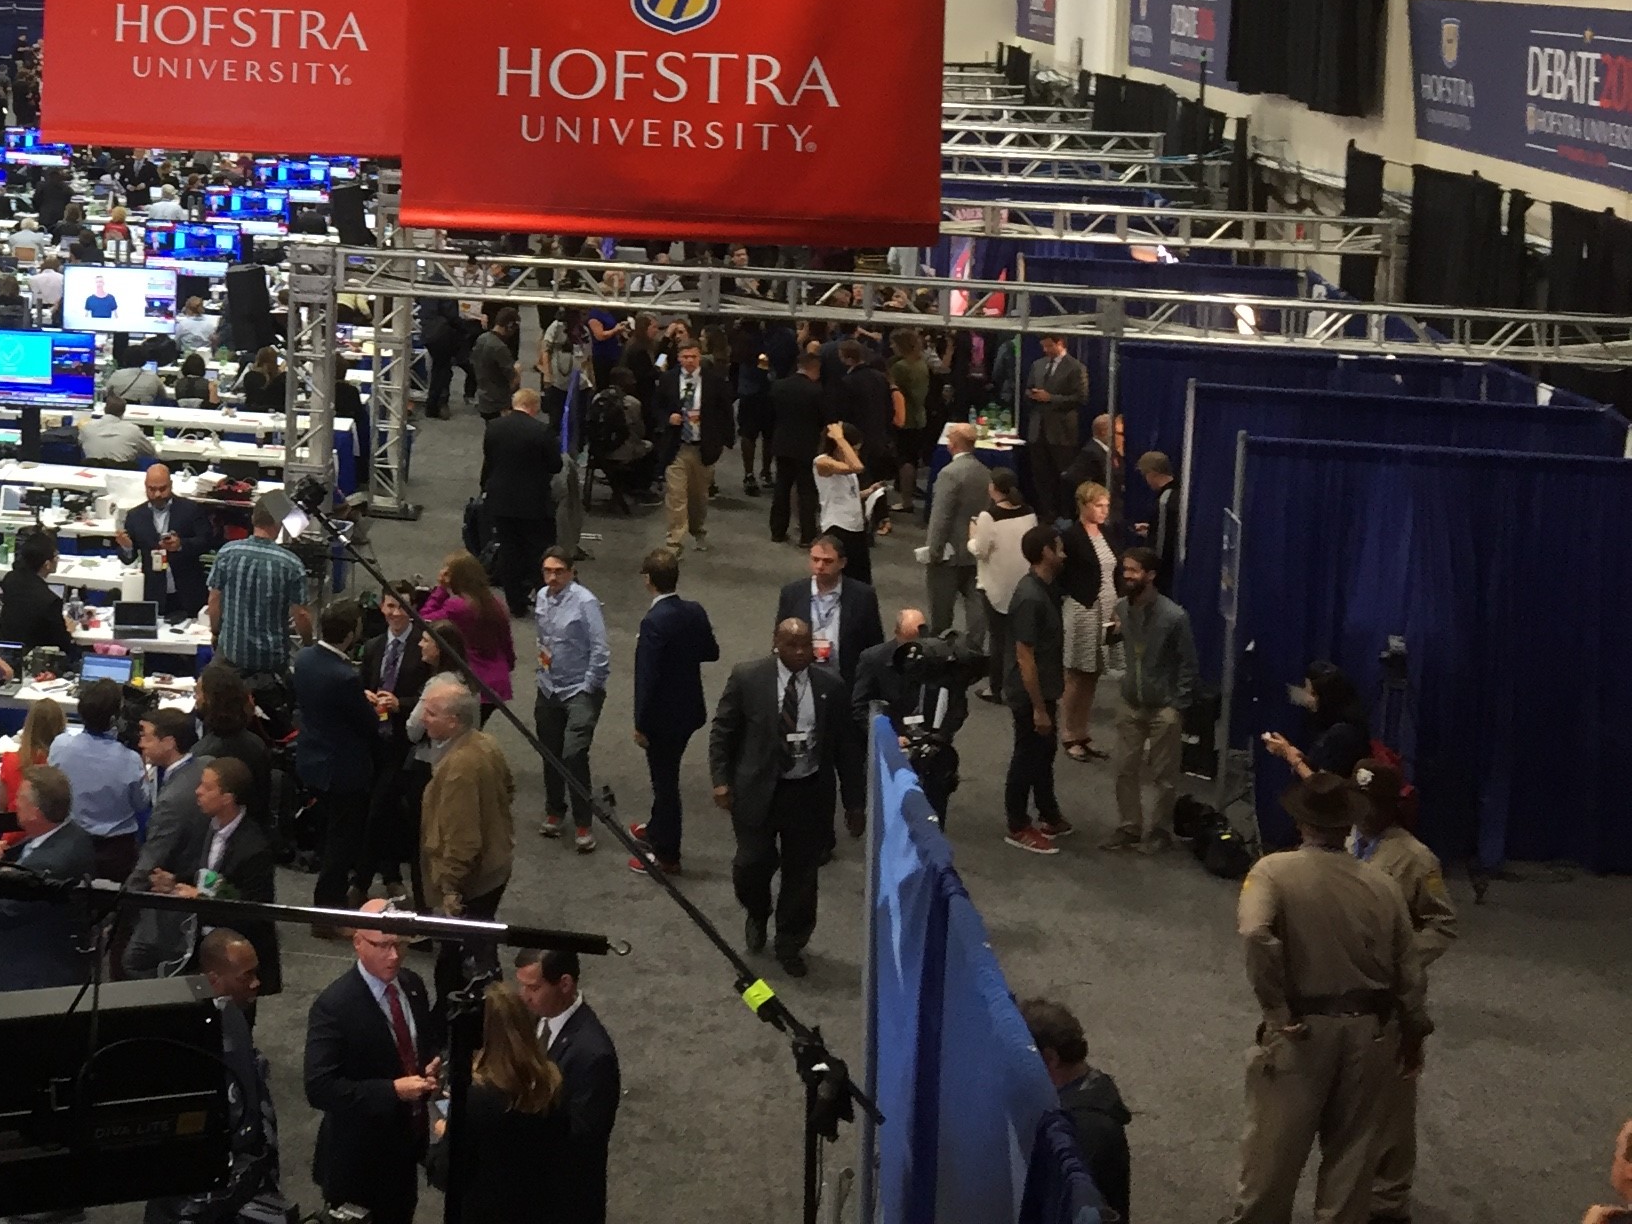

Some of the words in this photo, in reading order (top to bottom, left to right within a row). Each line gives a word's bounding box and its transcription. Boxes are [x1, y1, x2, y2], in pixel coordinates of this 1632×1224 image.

[115, 2, 369, 52] HOFSTRA
[132, 55, 346, 86] UNIVERSITY
[496, 46, 840, 109] HOFSTRA
[519, 113, 810, 154] UNIVERSITY
